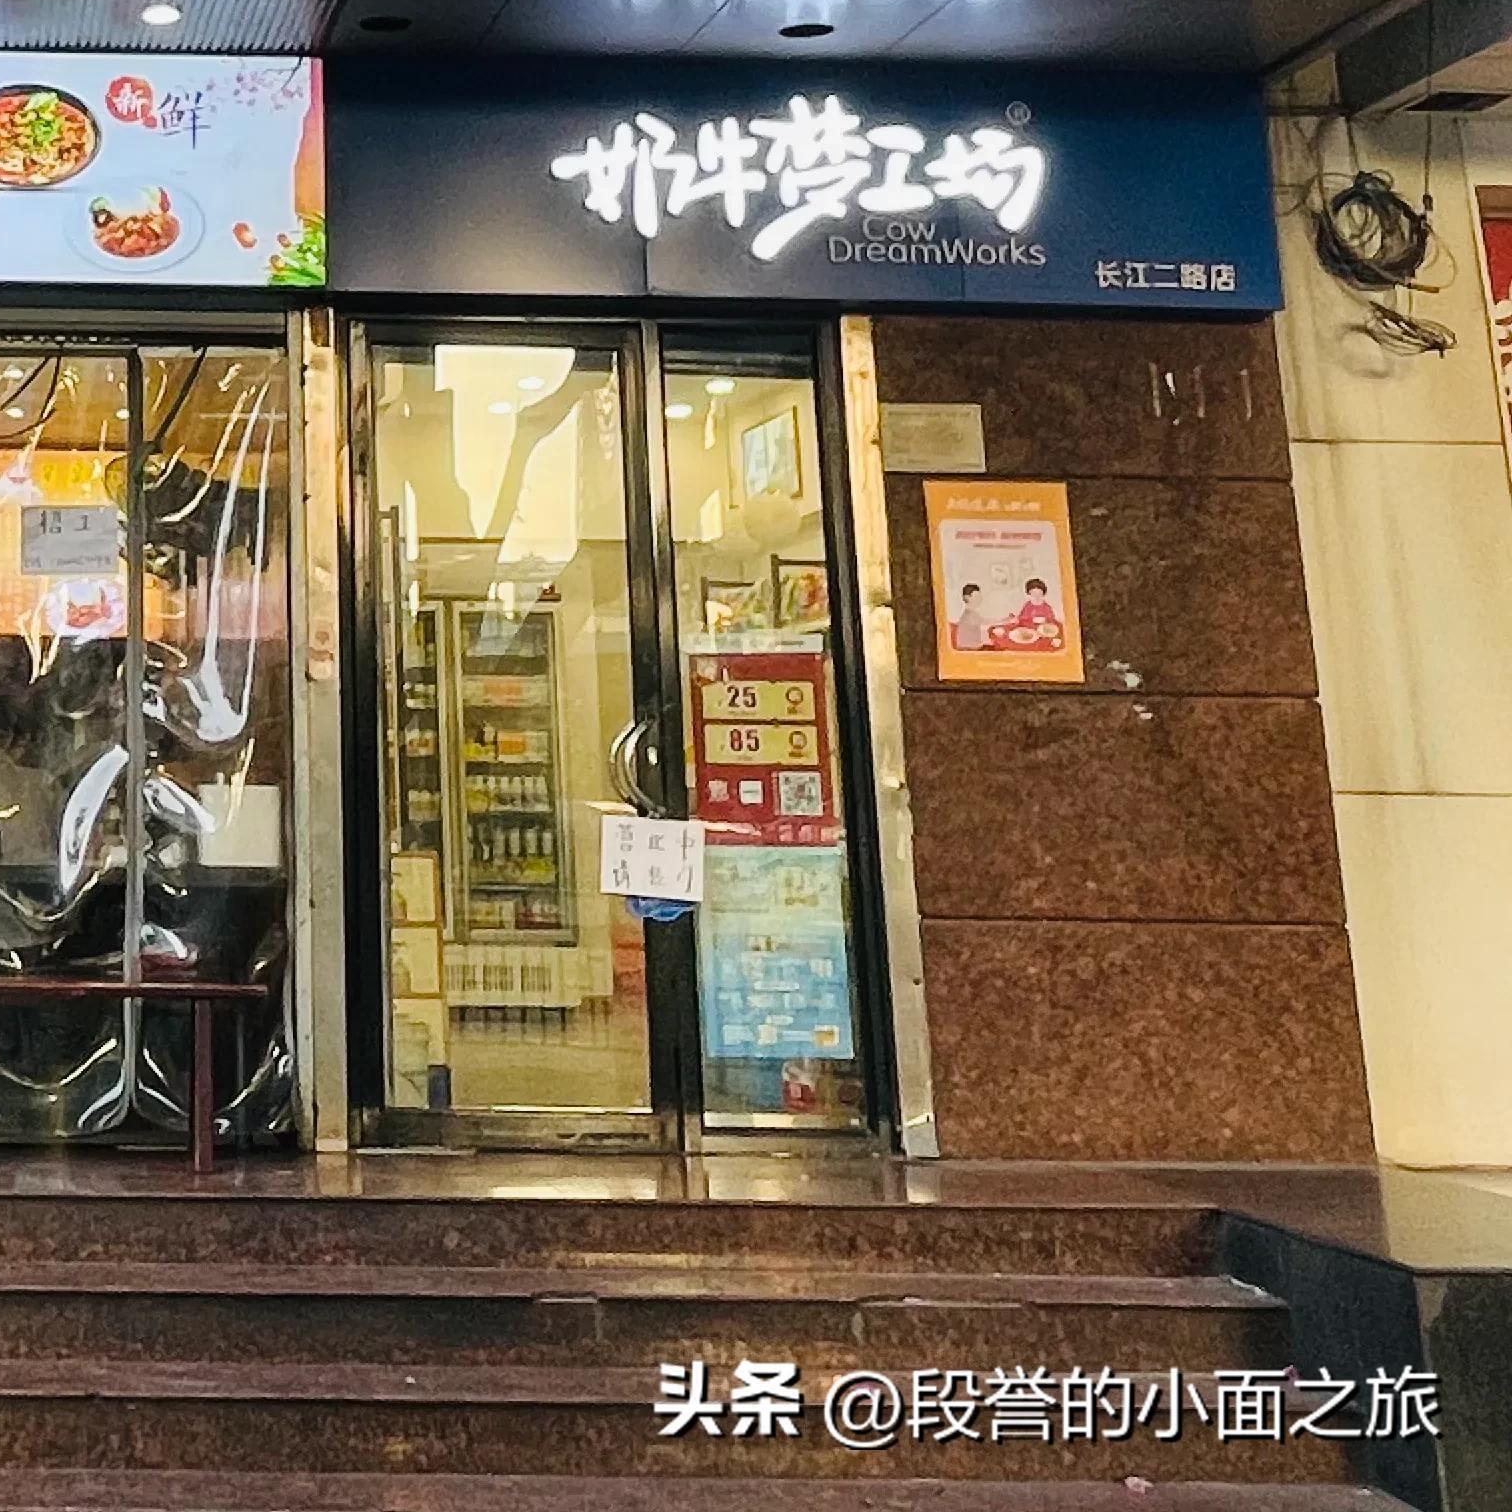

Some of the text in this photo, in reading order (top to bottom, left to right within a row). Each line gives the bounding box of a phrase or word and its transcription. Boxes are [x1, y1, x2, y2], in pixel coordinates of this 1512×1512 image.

[106, 76, 210, 149] 新鲜
[551, 94, 1045, 261] 奶牛梦工场
[862, 216, 936, 241] Cow
[828, 237, 1046, 266] DreamWorks
[1095, 260, 1237, 292] 长江二路店
[727, 686, 757, 708] 25
